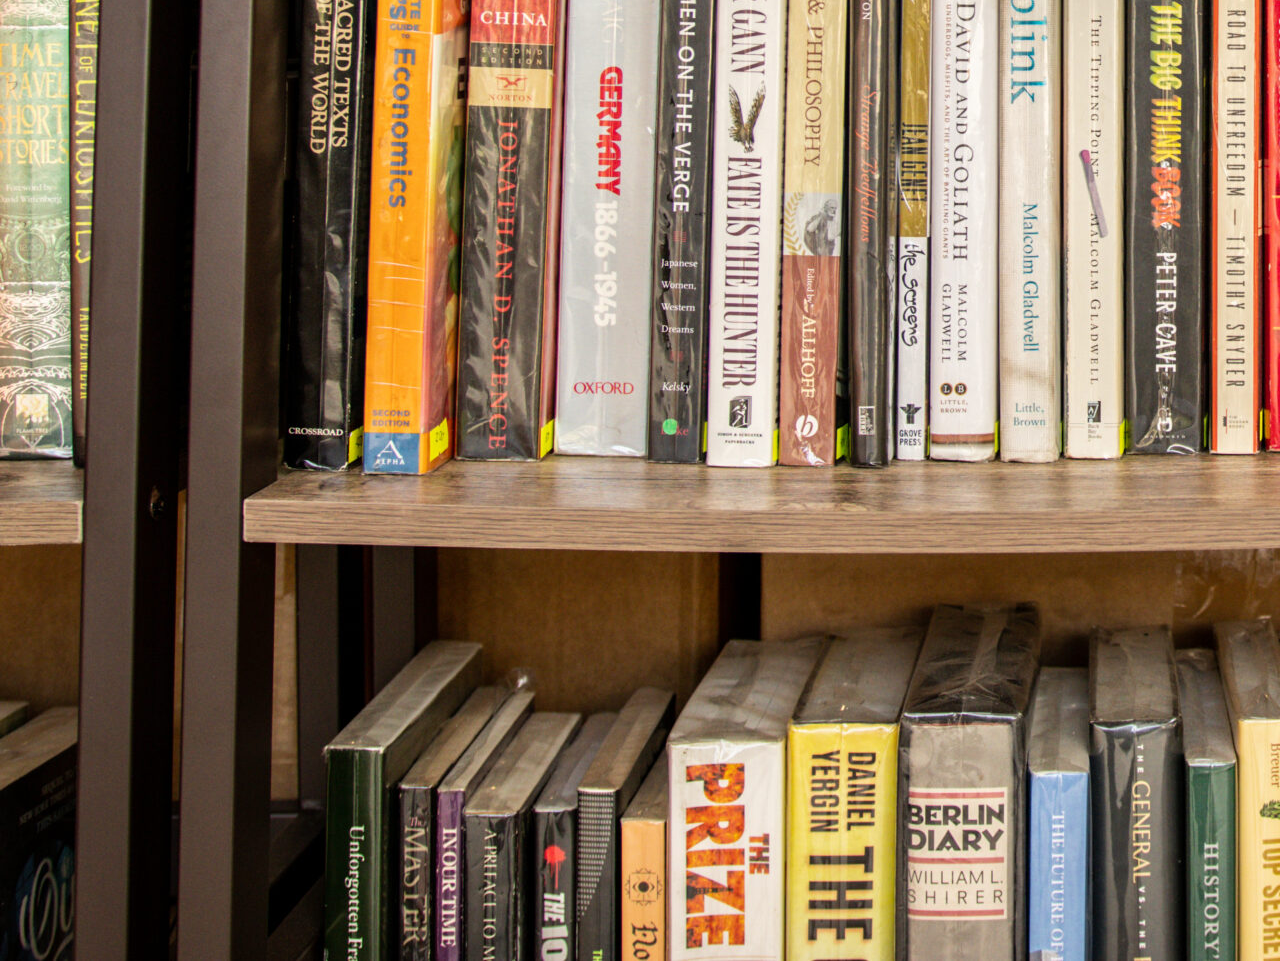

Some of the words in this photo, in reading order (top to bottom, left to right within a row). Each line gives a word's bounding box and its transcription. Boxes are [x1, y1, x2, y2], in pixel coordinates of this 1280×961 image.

[479, 10, 548, 27] CHINA
[730, 9, 768, 75] GANN
[955, 2, 976, 84] DAVID
[1227, 9, 1247, 51] ROAD
[676, 45, 694, 80] ON
[309, 71, 330, 154] WORLD
[330, 77, 352, 148] TEXTS
[388, 47, 416, 209] Economics
[674, 89, 693, 133] THE
[803, 25, 824, 167] PHILOSOPHY
[955, 93, 969, 135] AND
[594, 65, 623, 196] GERMANY
[902, 122, 928, 155] JEAN
[1226, 97, 1246, 196] UNFREEDOM
[495, 118, 517, 280] JONATHAN
[672, 142, 692, 213] VERGE
[726, 156, 762, 210] FATE
[953, 143, 974, 261] GOLIATH
[594, 200, 618, 327] 1866-1945
[660, 258, 698, 269] Japanese
[724, 242, 760, 288] THE
[1022, 203, 1040, 275] Malcolm
[1155, 252, 1177, 312] PETER
[1226, 236, 1246, 310] TIMOTHY
[661, 303, 696, 312] Western
[661, 325, 694, 334] Dreams
[722, 292, 759, 389] HUNTER
[941, 283, 951, 363] GLADWELL
[957, 284, 968, 362] MALCOLM
[1022, 281, 1040, 353] Gladwell
[800, 315, 817, 399] ALLHOFF
[1155, 323, 1177, 373] CAVE
[1226, 324, 1245, 387] SNYDER
[489, 337, 510, 450] SPENCE
[573, 381, 634, 395] OXFORD
[662, 381, 692, 394] Kelsky
[1014, 402, 1045, 415] Little,
[288, 427, 344, 436] CROSSROAD
[1013, 417, 1046, 427] Brown
[810, 750, 841, 833] YERGIN
[847, 751, 877, 832] DANIEL
[907, 804, 1005, 825] BERLIN
[685, 762, 746, 950] PRIZE
[749, 833, 770, 875] THE
[907, 829, 1005, 852] DIARY
[1132, 780, 1151, 884] GENERAL
[345, 825, 365, 932] Unforgotten
[403, 826, 429, 945] MASTER
[543, 892, 565, 922] THE
[807, 845, 875, 942] THE
[907, 890, 1004, 905] SHIRER
[908, 870, 985, 884] WILLIAM
[440, 896, 457, 947] TIME
